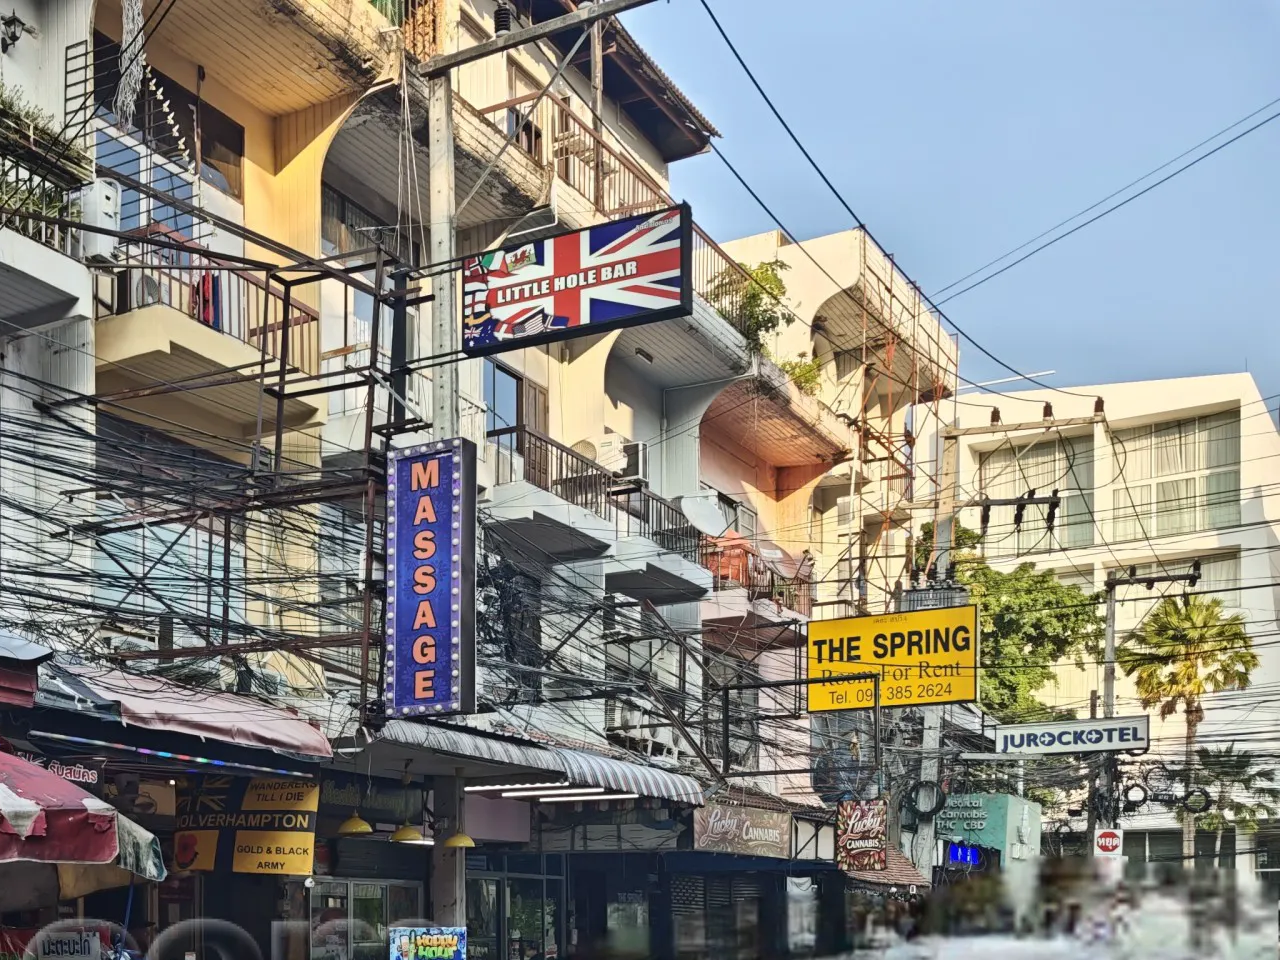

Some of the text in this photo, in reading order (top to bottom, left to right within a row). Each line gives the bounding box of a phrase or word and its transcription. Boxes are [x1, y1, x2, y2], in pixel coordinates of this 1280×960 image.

[496, 260, 638, 305] LITTLE HOLE BAR
[409, 458, 441, 701] MASSAGE
[812, 625, 971, 664] THE SPRING
[881, 664, 912, 682] For
[918, 660, 962, 680] Rent
[829, 690, 852, 705] Tel.
[886, 684, 913, 701] 385
[917, 682, 953, 699] 2624
[257, 793, 279, 802] TILL
[286, 792, 305, 801] DIE
[940, 809, 989, 819] Cannabis
[699, 808, 781, 847] Lucky CANNABIS
[839, 806, 883, 846] Lucky
[936, 820, 987, 830] THC CBD
[236, 845, 309, 856] GOLD & BLACK
[846, 838, 880, 849] CANNABIS
[1097, 836, 1121, 850] หยุด
[257, 861, 286, 870] ARMY
